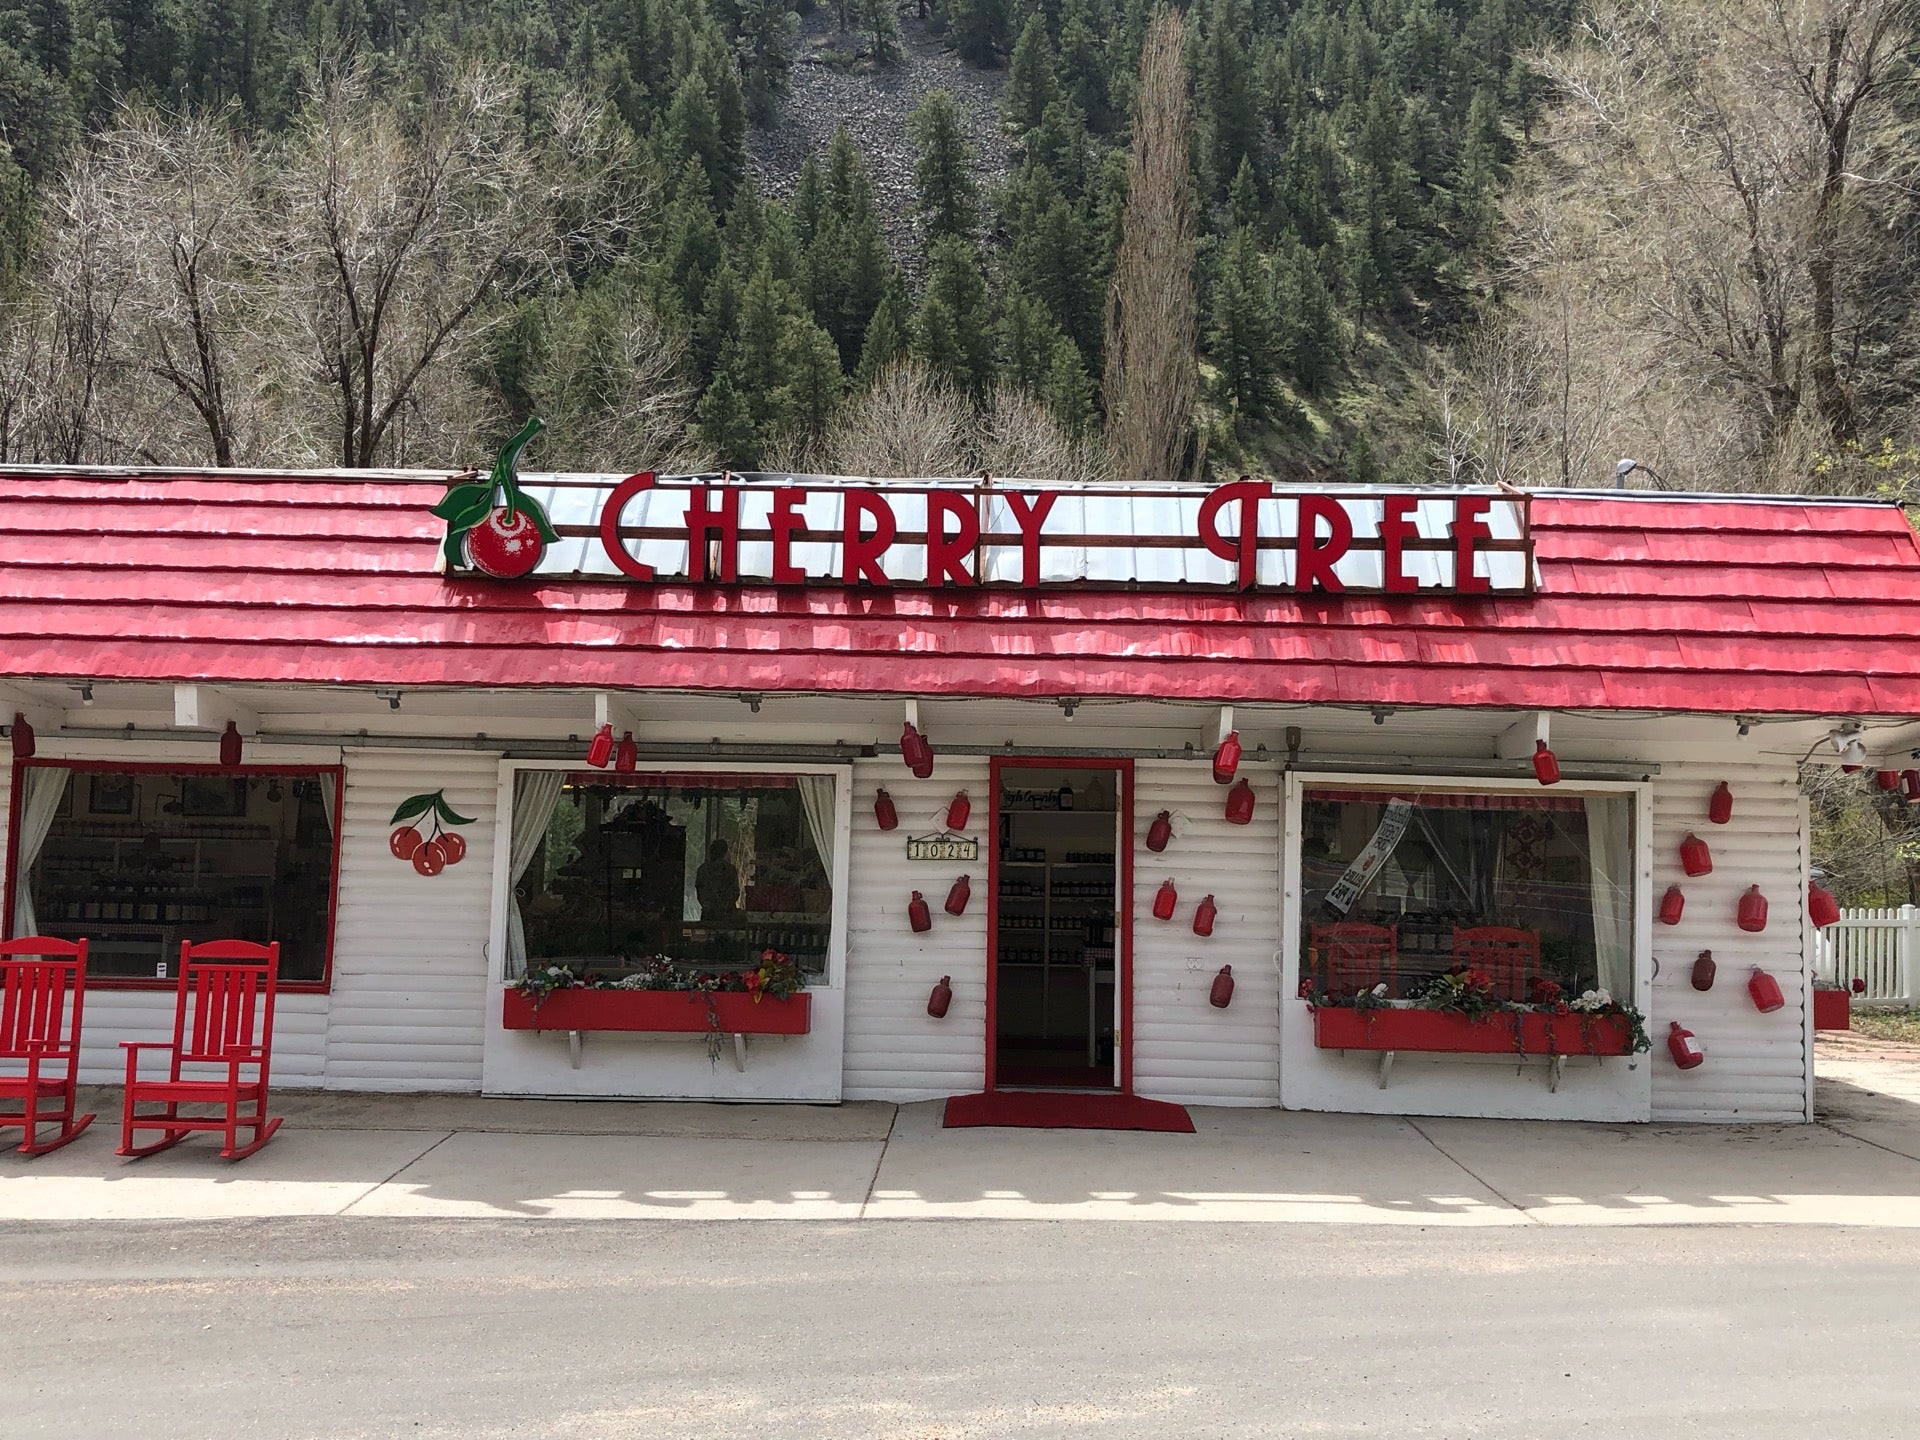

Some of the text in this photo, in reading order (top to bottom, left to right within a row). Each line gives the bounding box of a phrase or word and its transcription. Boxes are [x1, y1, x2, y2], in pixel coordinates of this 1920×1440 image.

[600, 471, 1491, 593] CHERRY TREE
[915, 844, 970, 857] 1024
